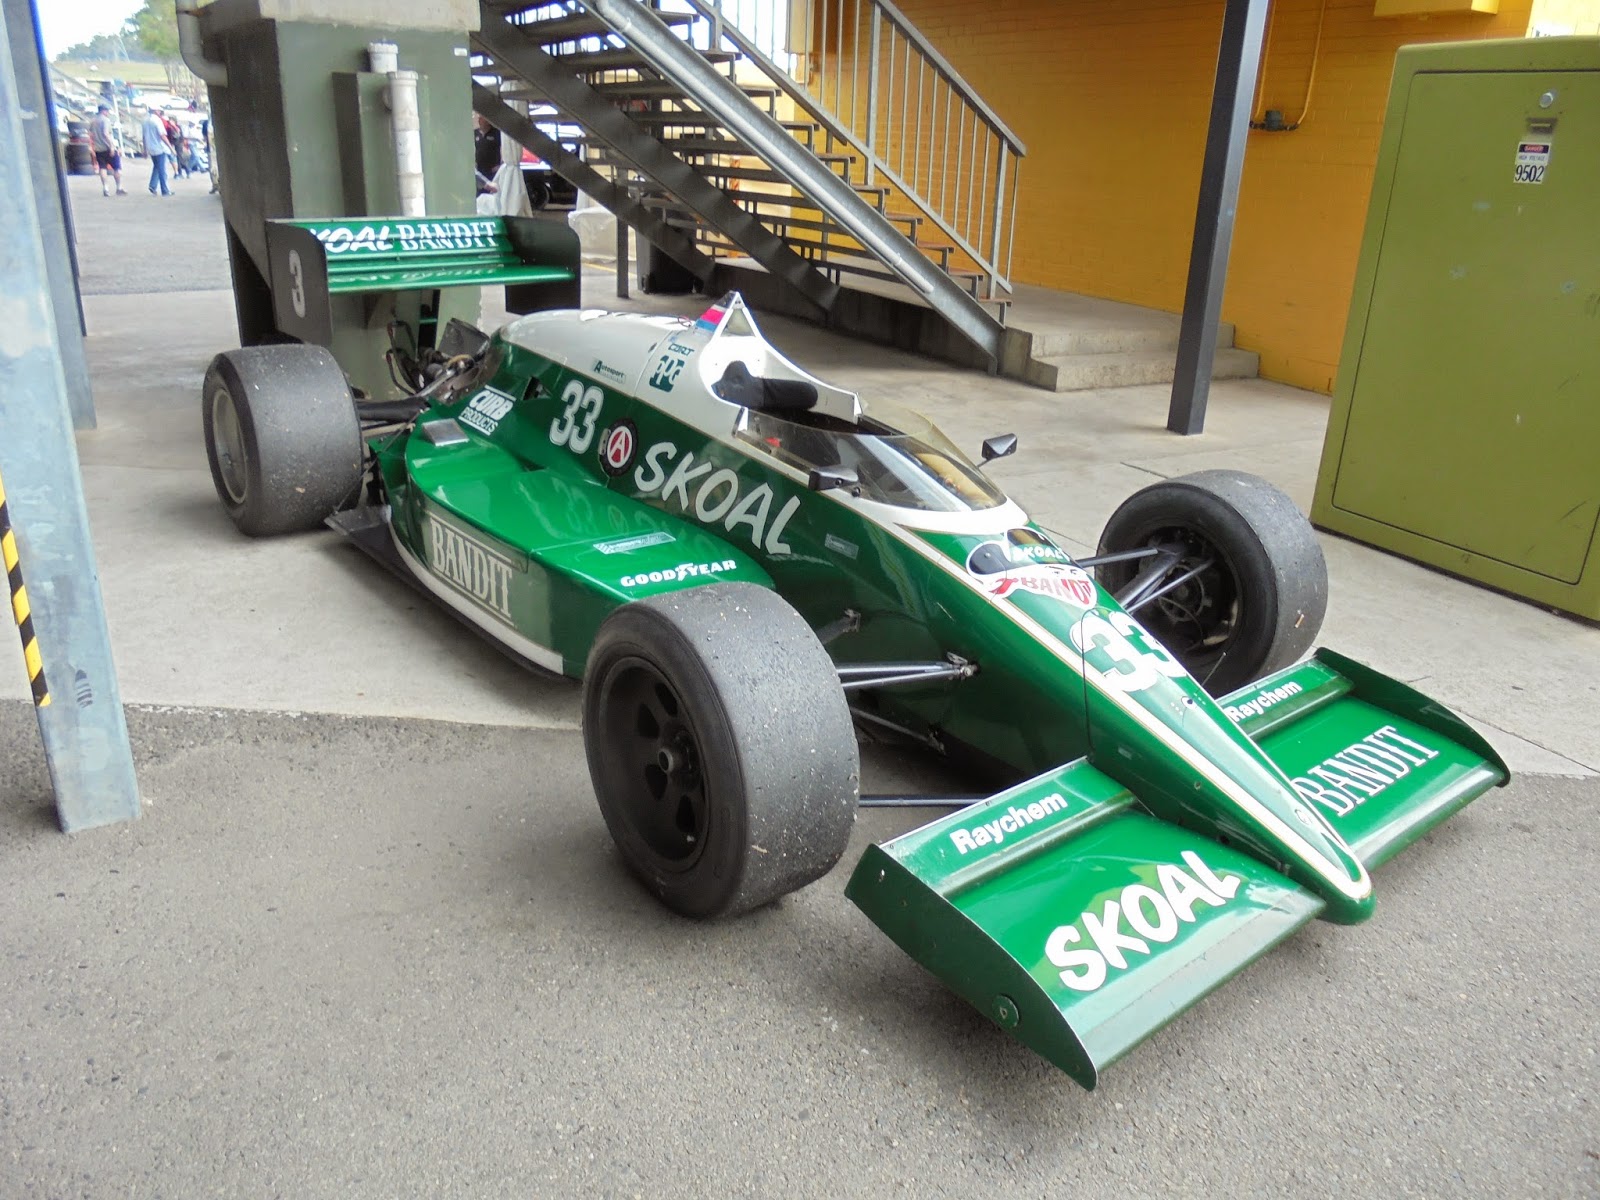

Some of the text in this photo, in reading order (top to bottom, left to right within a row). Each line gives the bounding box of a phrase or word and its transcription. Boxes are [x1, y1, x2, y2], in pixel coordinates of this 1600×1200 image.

[1514, 164, 1545, 183] 9502
[396, 222, 498, 251] BANDIT
[288, 249, 306, 318] 3
[460, 406, 499, 433] PRODUCTS
[469, 390, 514, 421] CURB
[549, 380, 604, 454] 33
[634, 441, 801, 555] SKOAL
[430, 518, 513, 618] BANDIT
[620, 559, 737, 587] GOODYEAR
[1070, 610, 1187, 692] 33
[1225, 681, 1302, 723] Raychem
[1292, 725, 1440, 817] BANDIT
[950, 792, 1068, 855] Raychem
[1044, 851, 1241, 993] SKOAL
